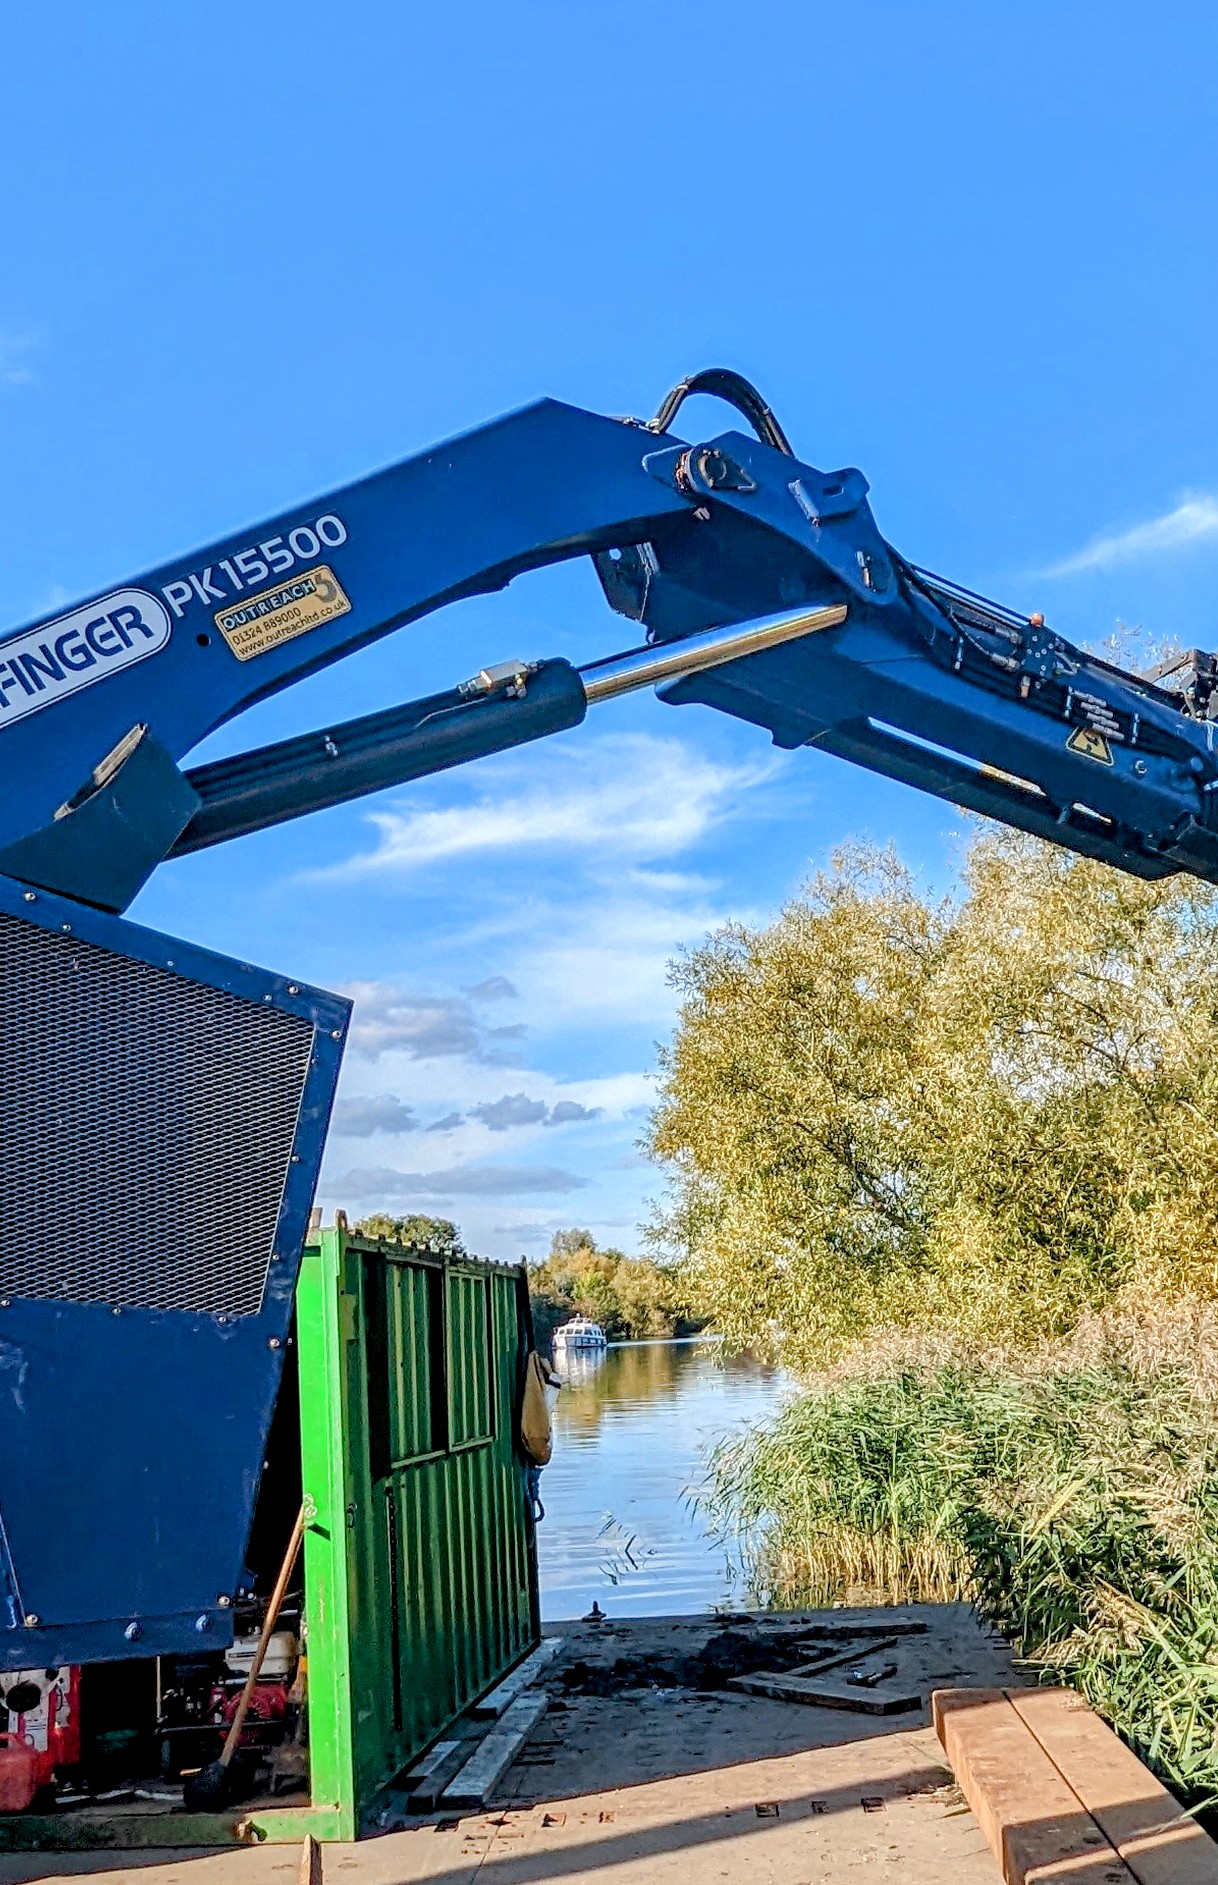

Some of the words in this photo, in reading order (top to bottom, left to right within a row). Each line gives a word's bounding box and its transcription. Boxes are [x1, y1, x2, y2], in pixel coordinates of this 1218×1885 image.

[162, 515, 348, 618] PK15500
[223, 579, 316, 630] OUTREACH
[232, 626, 263, 645] 01324
[263, 608, 302, 630] 889000
